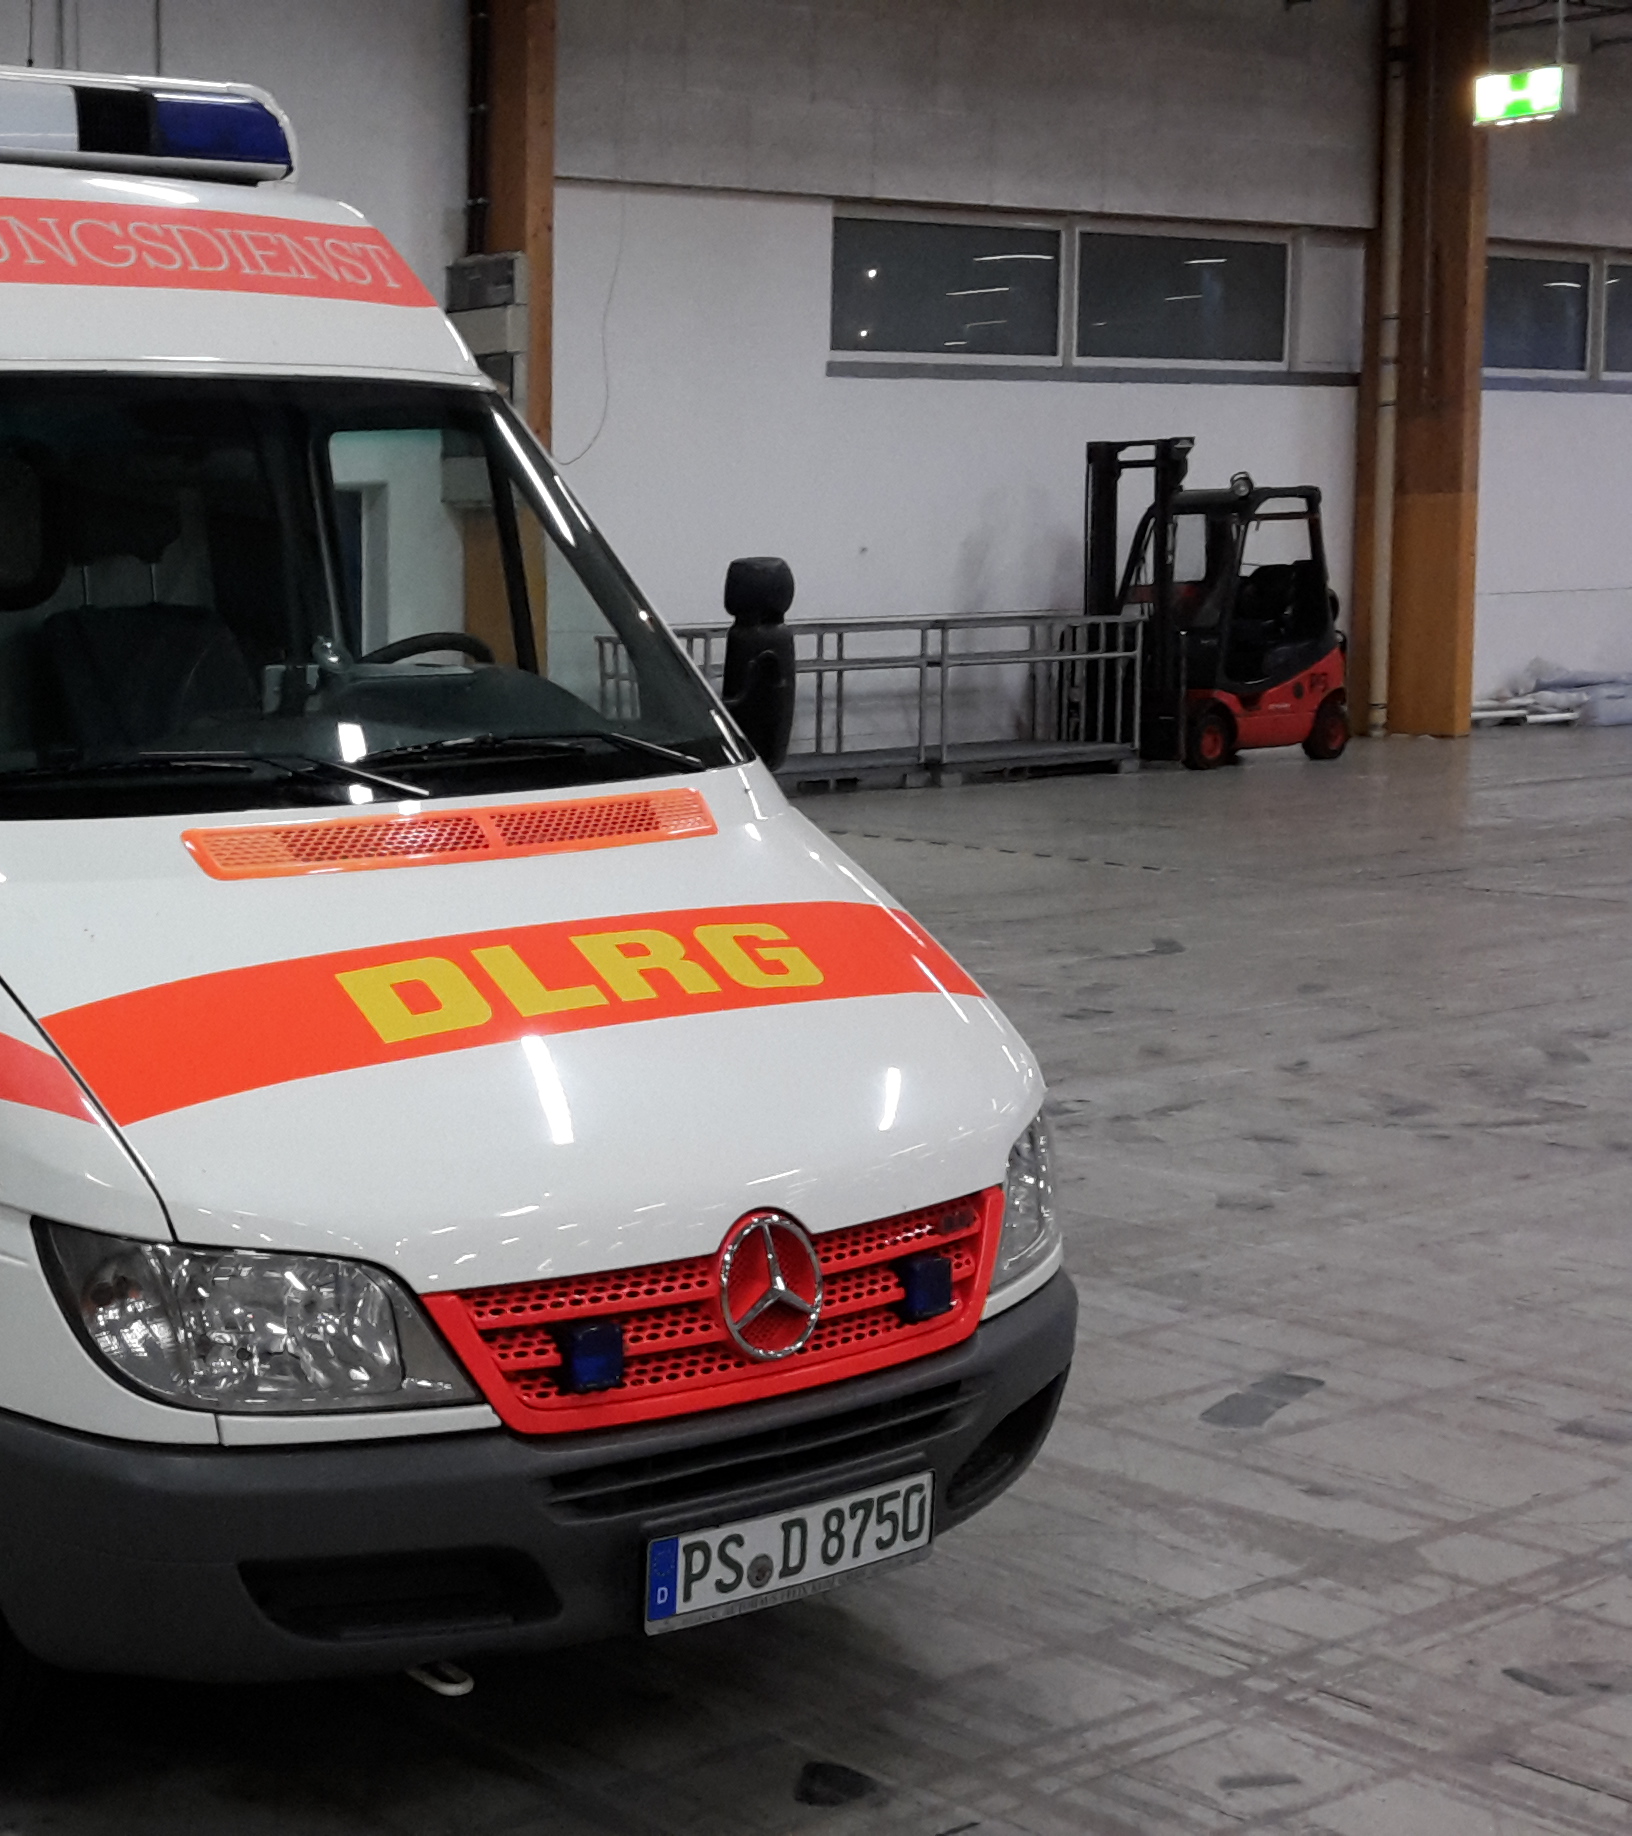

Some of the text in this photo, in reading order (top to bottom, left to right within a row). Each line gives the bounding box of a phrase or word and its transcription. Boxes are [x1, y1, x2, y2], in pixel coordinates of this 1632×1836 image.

[334, 923, 825, 1045] DLRG
[656, 1586, 668, 1605] D
[681, 1533, 745, 1603] PS
[778, 1517, 808, 1579] D
[821, 1482, 928, 1566] 8750
